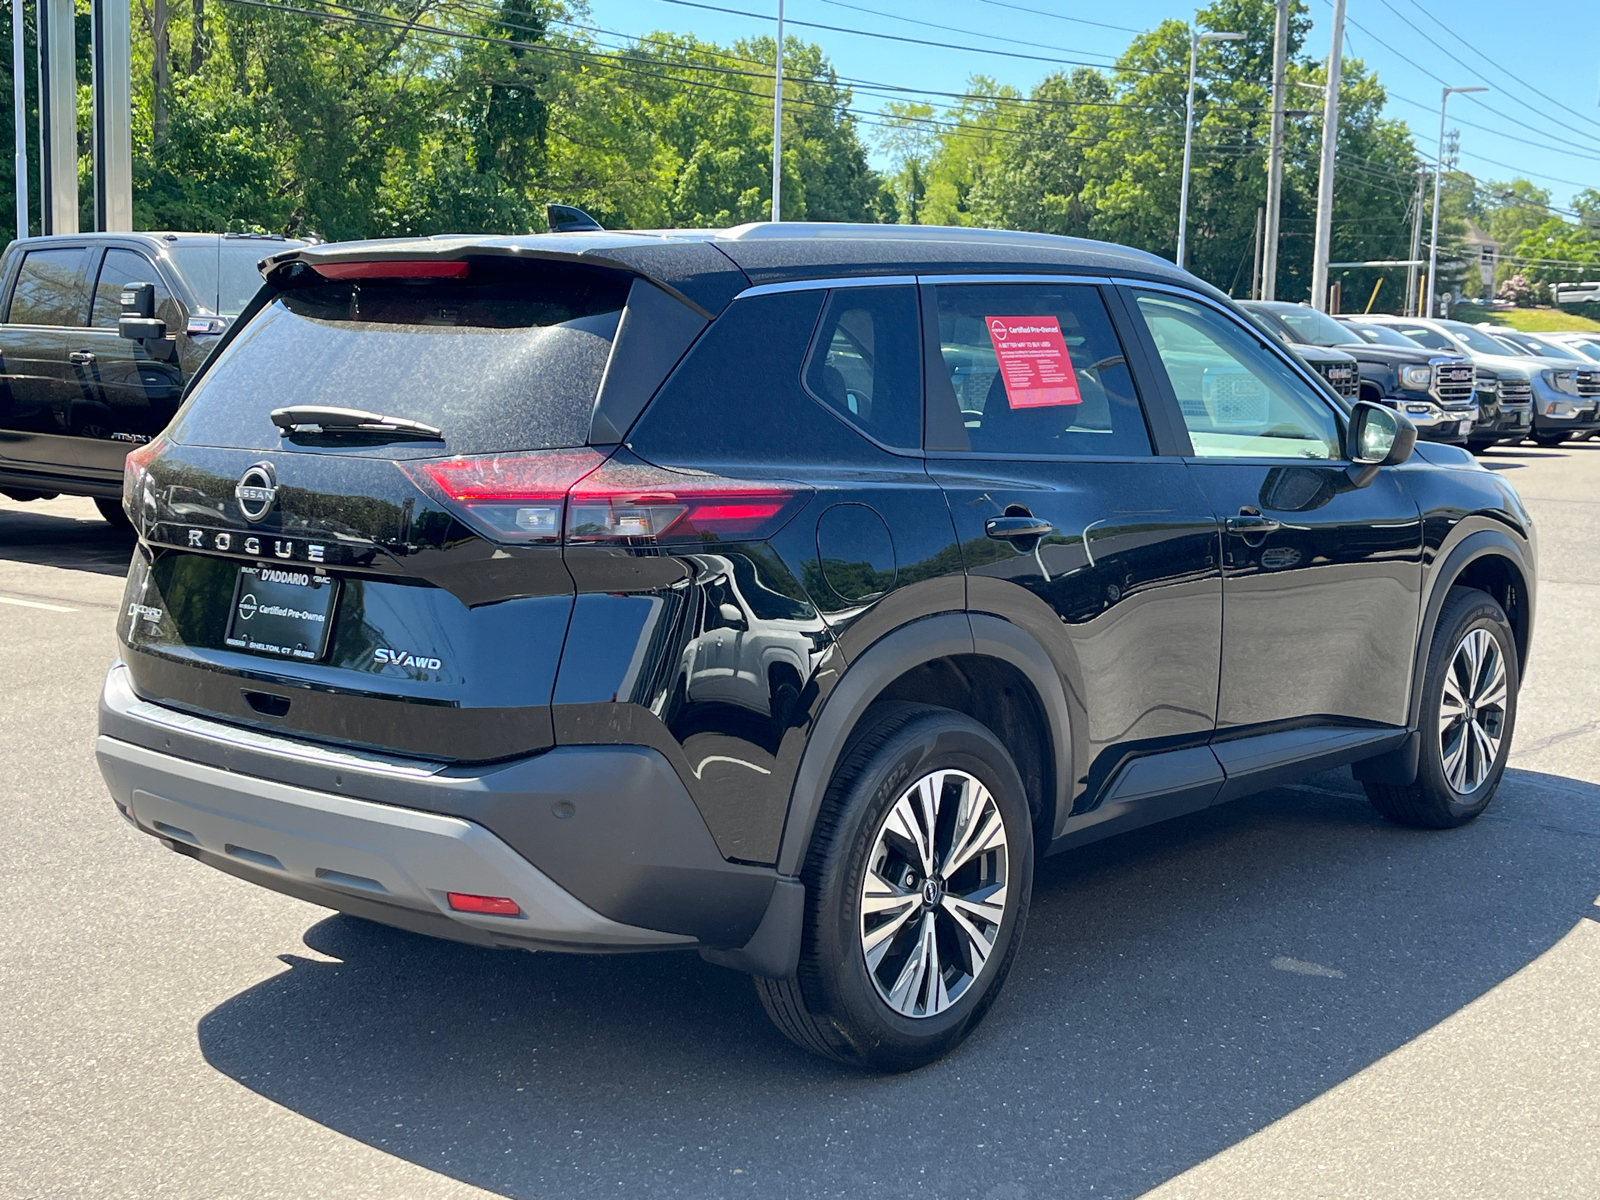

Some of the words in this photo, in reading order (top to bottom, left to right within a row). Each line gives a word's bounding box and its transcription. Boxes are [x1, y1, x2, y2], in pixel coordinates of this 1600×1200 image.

[236, 488, 274, 500] SSAN
[188, 529, 325, 562] ROGUE
[261, 569, 309, 586] D'ADDARIO
[259, 605, 288, 617] Certified
[249, 641, 280, 654] SHELTON,
[281, 647, 292, 655] CT
[374, 648, 407, 664] SV
[402, 656, 442, 670] AWD
